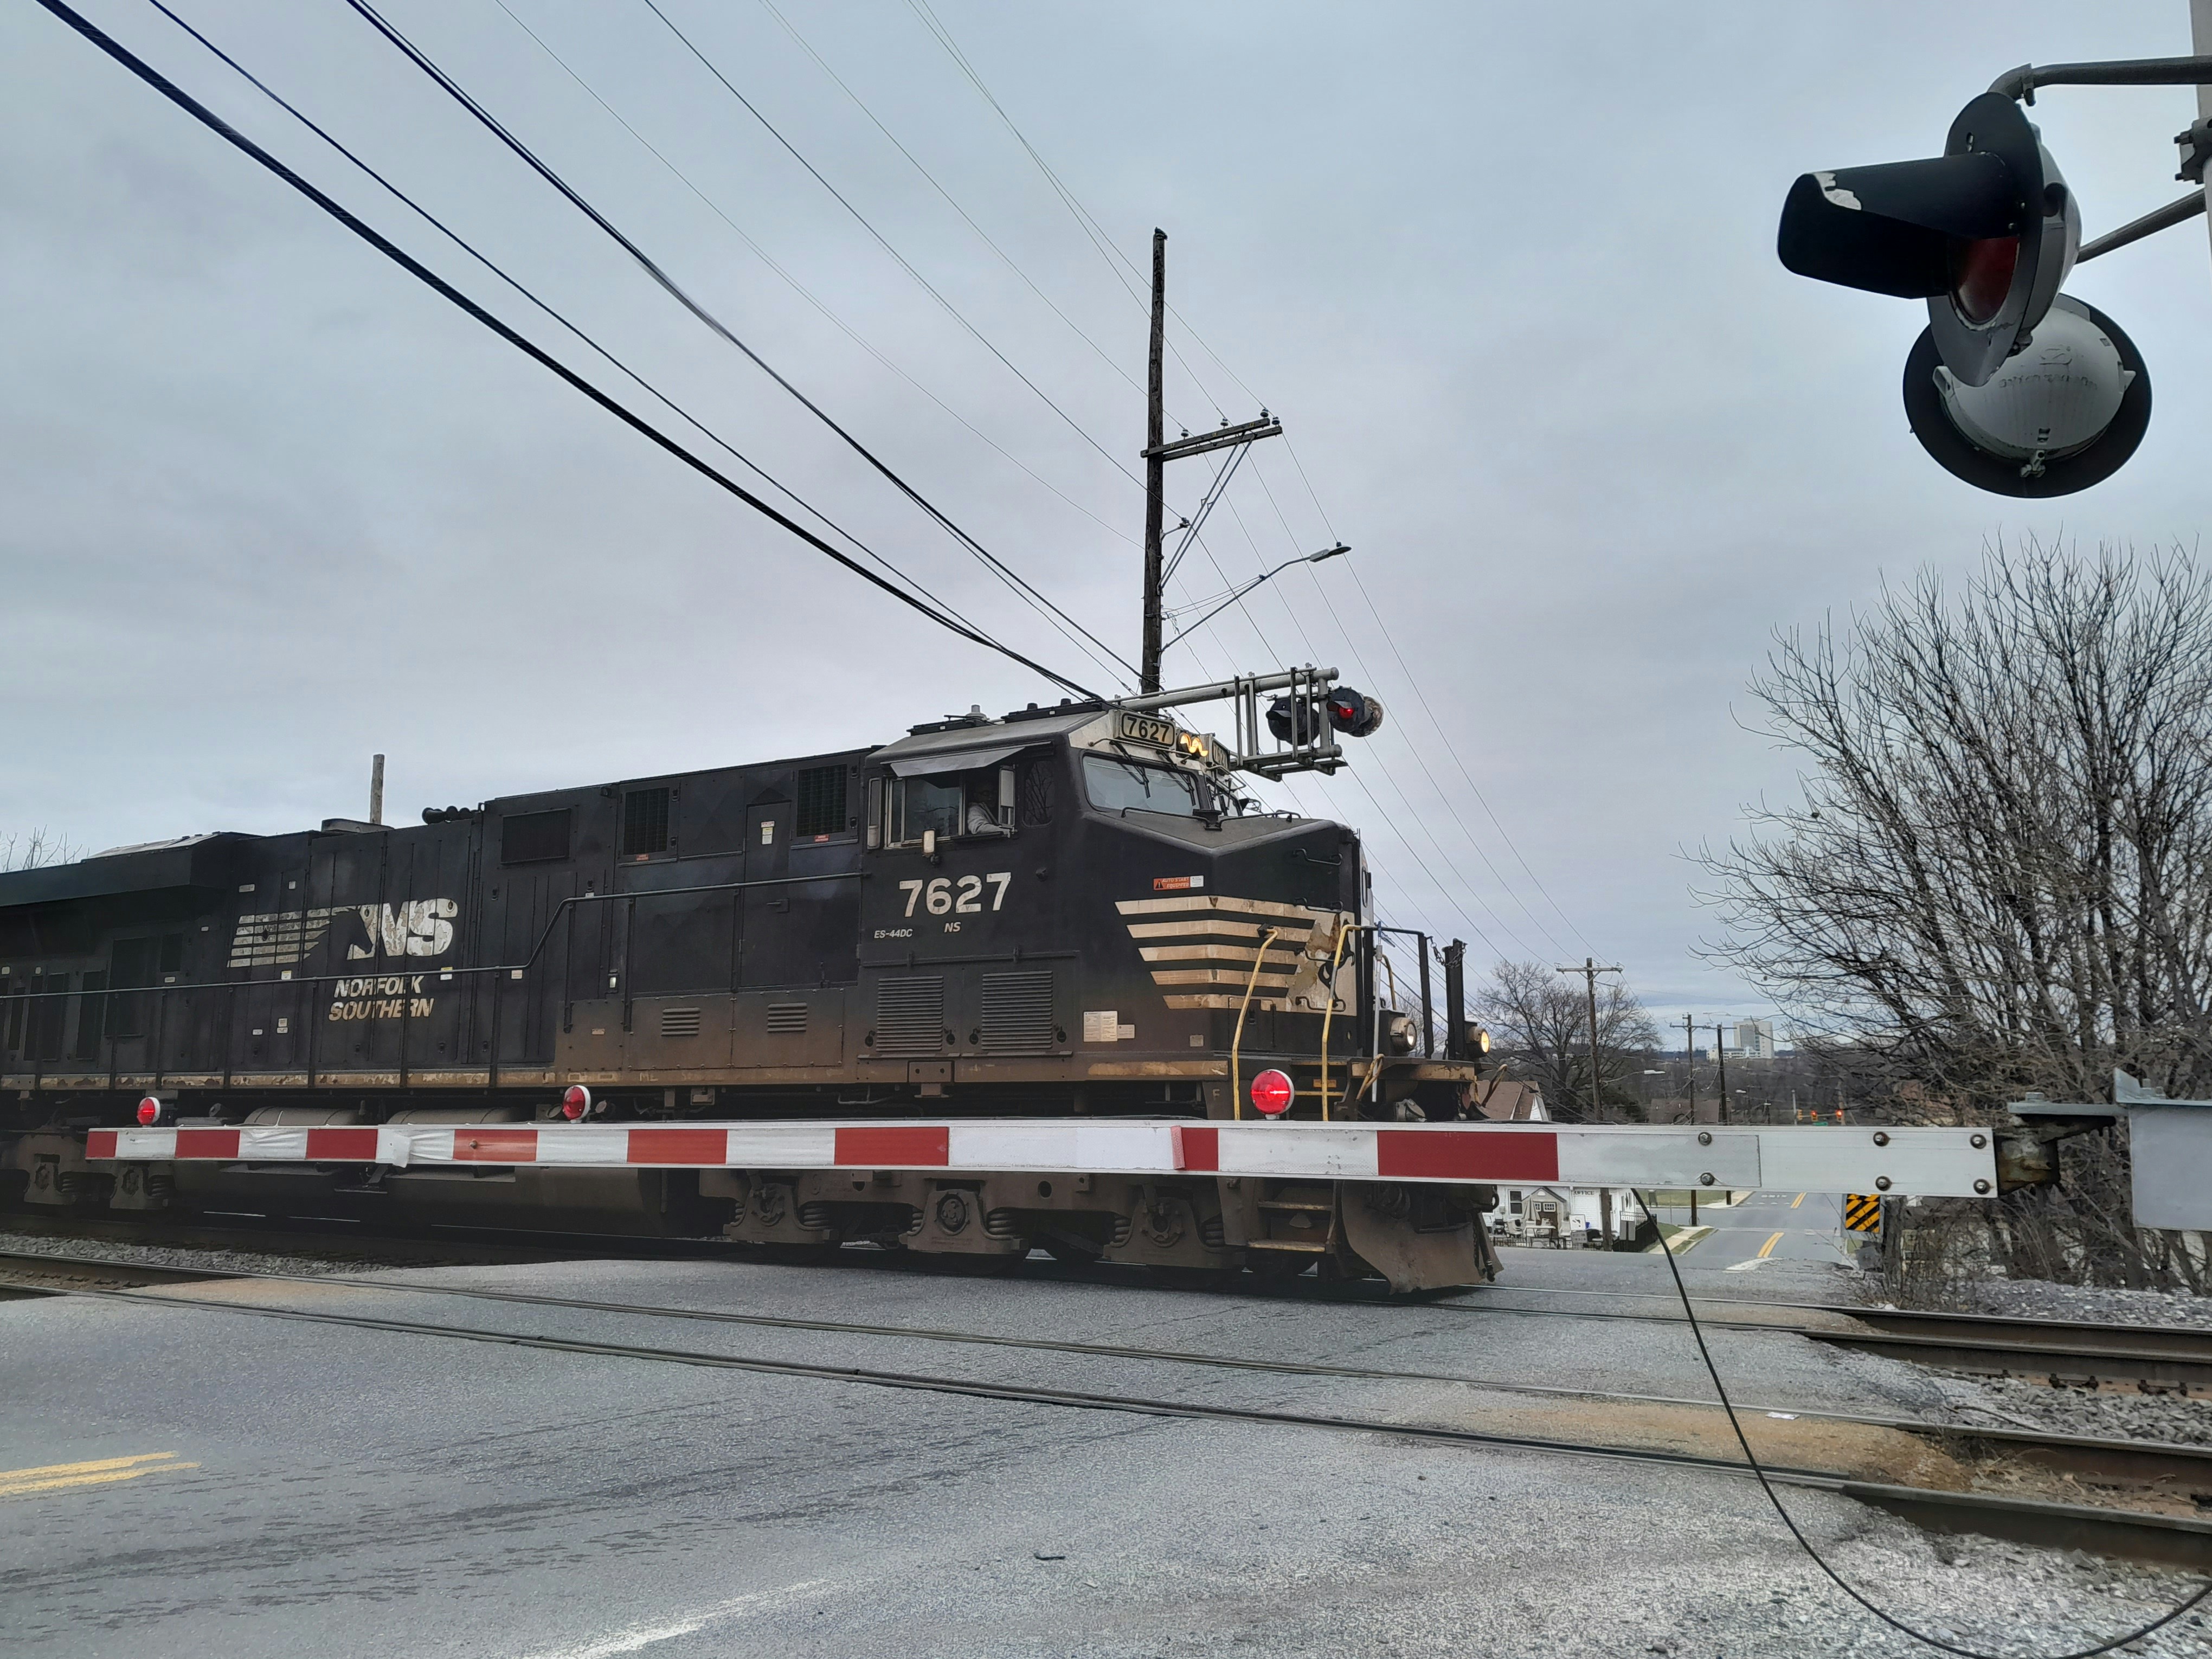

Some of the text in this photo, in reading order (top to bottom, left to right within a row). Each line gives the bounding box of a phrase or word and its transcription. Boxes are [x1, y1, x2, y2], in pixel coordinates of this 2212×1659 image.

[1127, 716, 1170, 742] 7627
[899, 872, 1011, 917] 7627
[346, 898, 459, 960] NS
[873, 928, 913, 938] ES-44DC
[943, 922, 961, 933] NS
[333, 975, 425, 998] NORFOLK
[329, 998, 434, 1021] SOUTHERN
